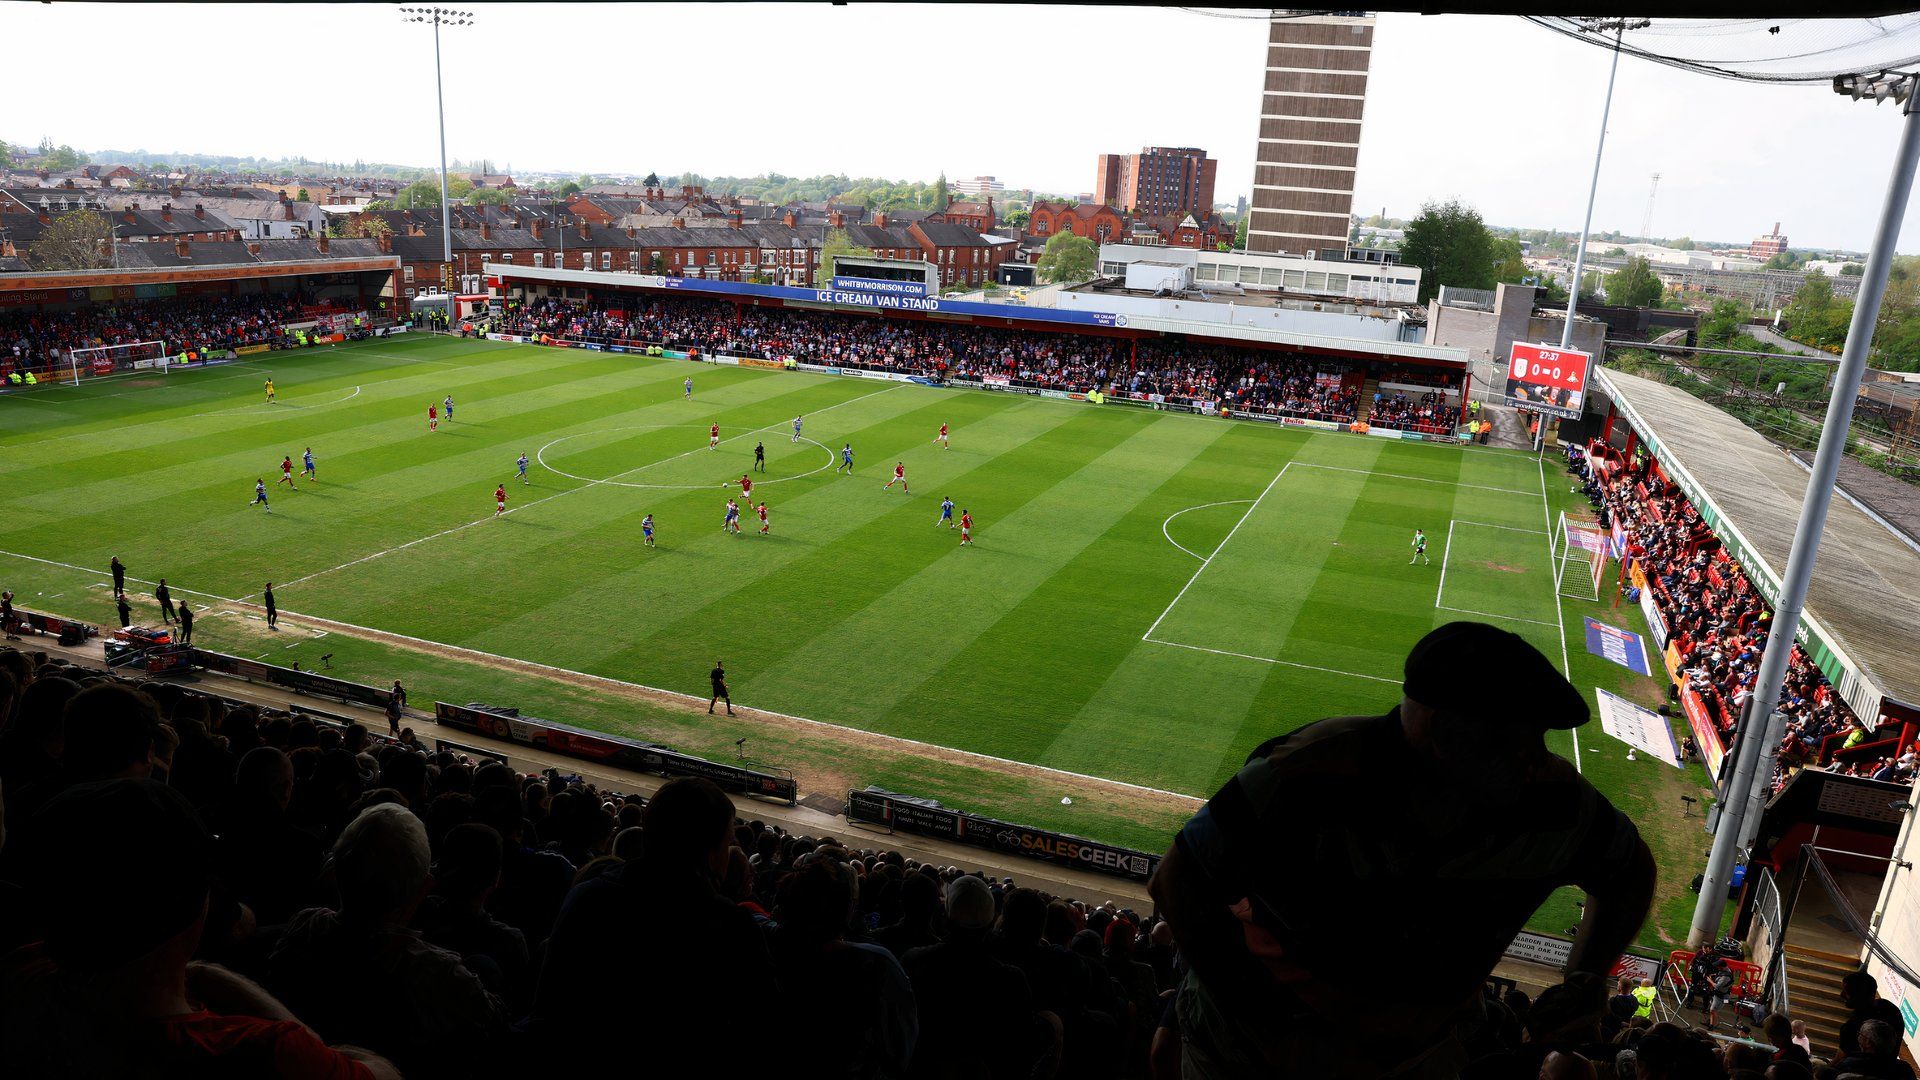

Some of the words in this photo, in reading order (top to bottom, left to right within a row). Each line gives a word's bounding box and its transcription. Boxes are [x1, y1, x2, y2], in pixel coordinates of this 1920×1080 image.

[837, 279, 923, 294] WHITBYMORRISON.COM
[816, 290, 832, 302] ICE
[835, 292, 873, 305] CREAM
[876, 295, 899, 307] VAN
[902, 297, 939, 310] STAND
[1532, 363, 1540, 376] 0
[1552, 367, 1561, 379] 0
[1020, 832, 1131, 872] SALESGEEK
[1515, 936, 1542, 946] GARDEN
